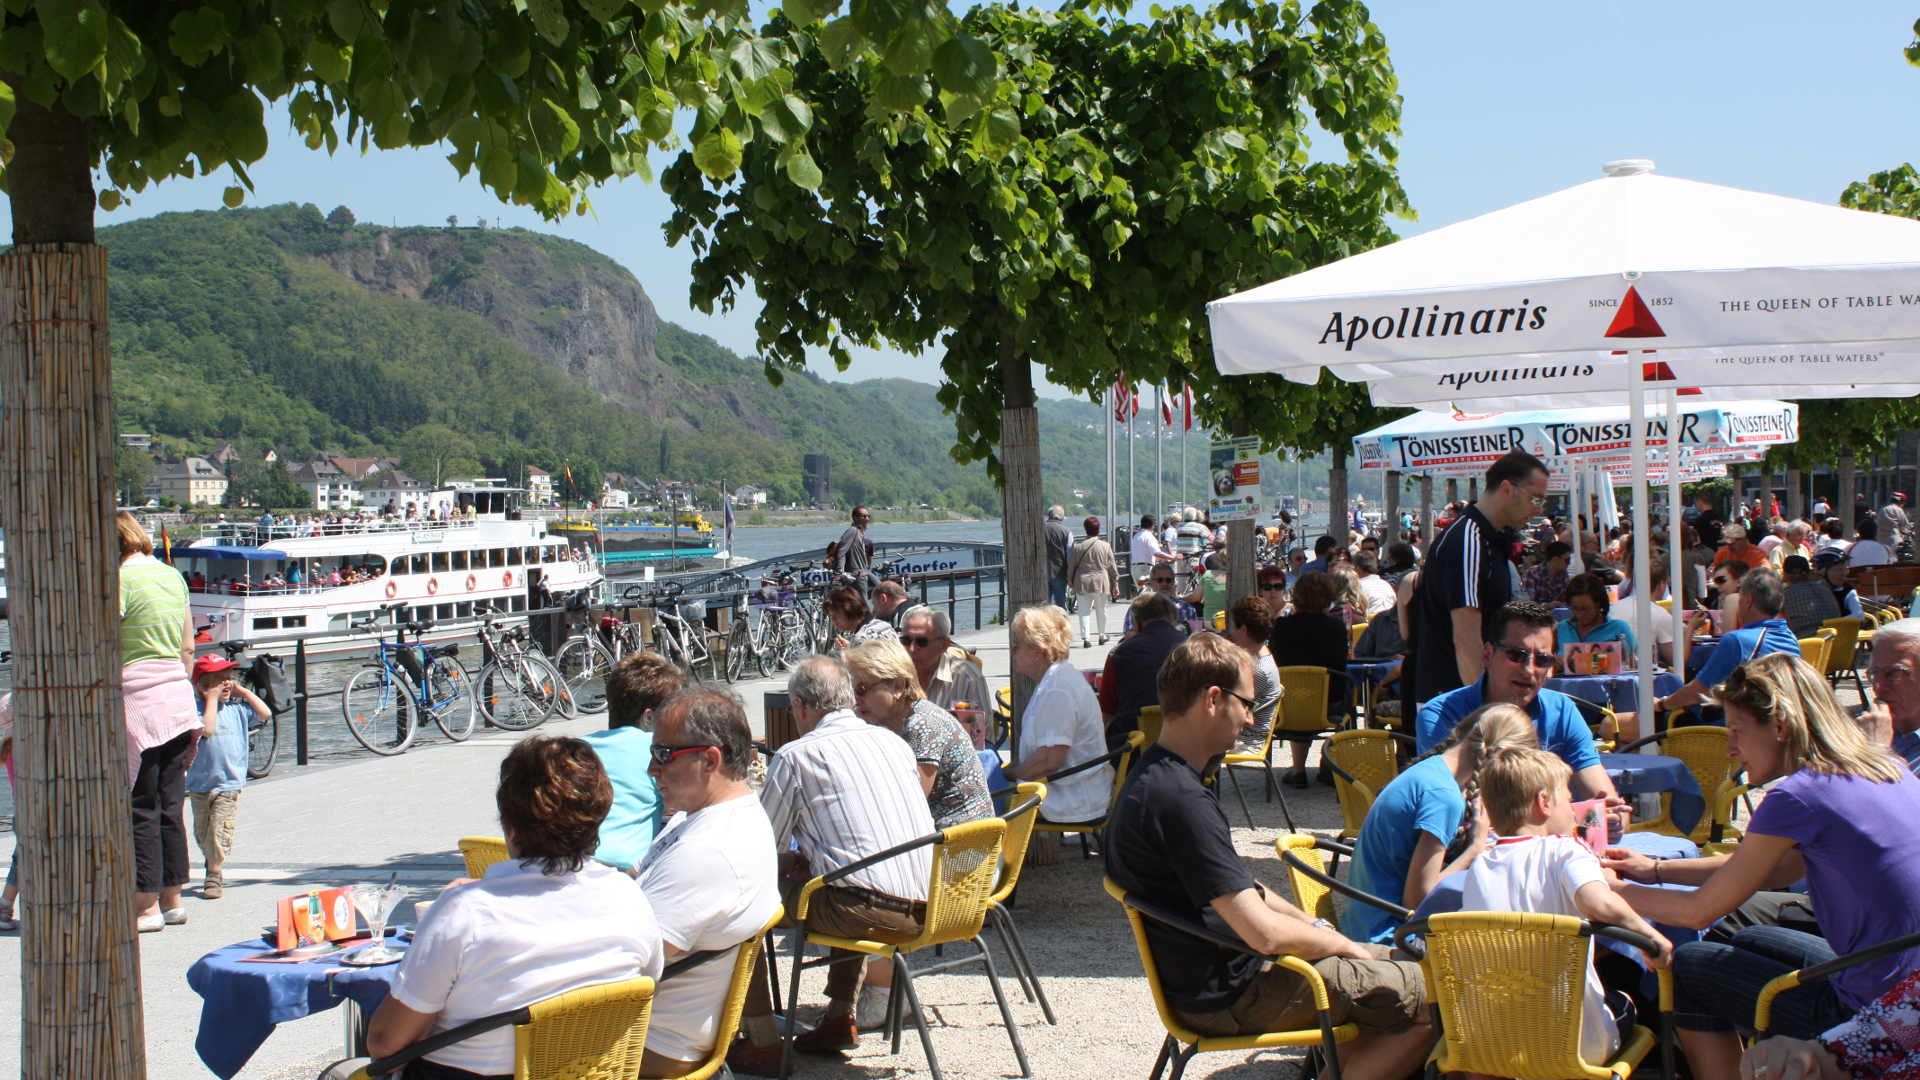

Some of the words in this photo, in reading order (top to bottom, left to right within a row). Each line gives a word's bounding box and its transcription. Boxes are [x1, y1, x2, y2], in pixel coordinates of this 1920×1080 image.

[1589, 298, 1618, 308] SINCE
[1651, 297, 1673, 306] 1852
[1720, 300, 1750, 312] THE
[1757, 298, 1811, 312] QUEEN
[1818, 297, 1839, 308] OF
[1845, 295, 1893, 308] TABLE
[1318, 298, 1549, 351] Apollinaris
[1739, 355, 1776, 365] QUEEN
[1780, 354, 1794, 364] OF
[1800, 354, 1831, 363] TABLE
[1392, 427, 1524, 467] TÖNISSTEINER
